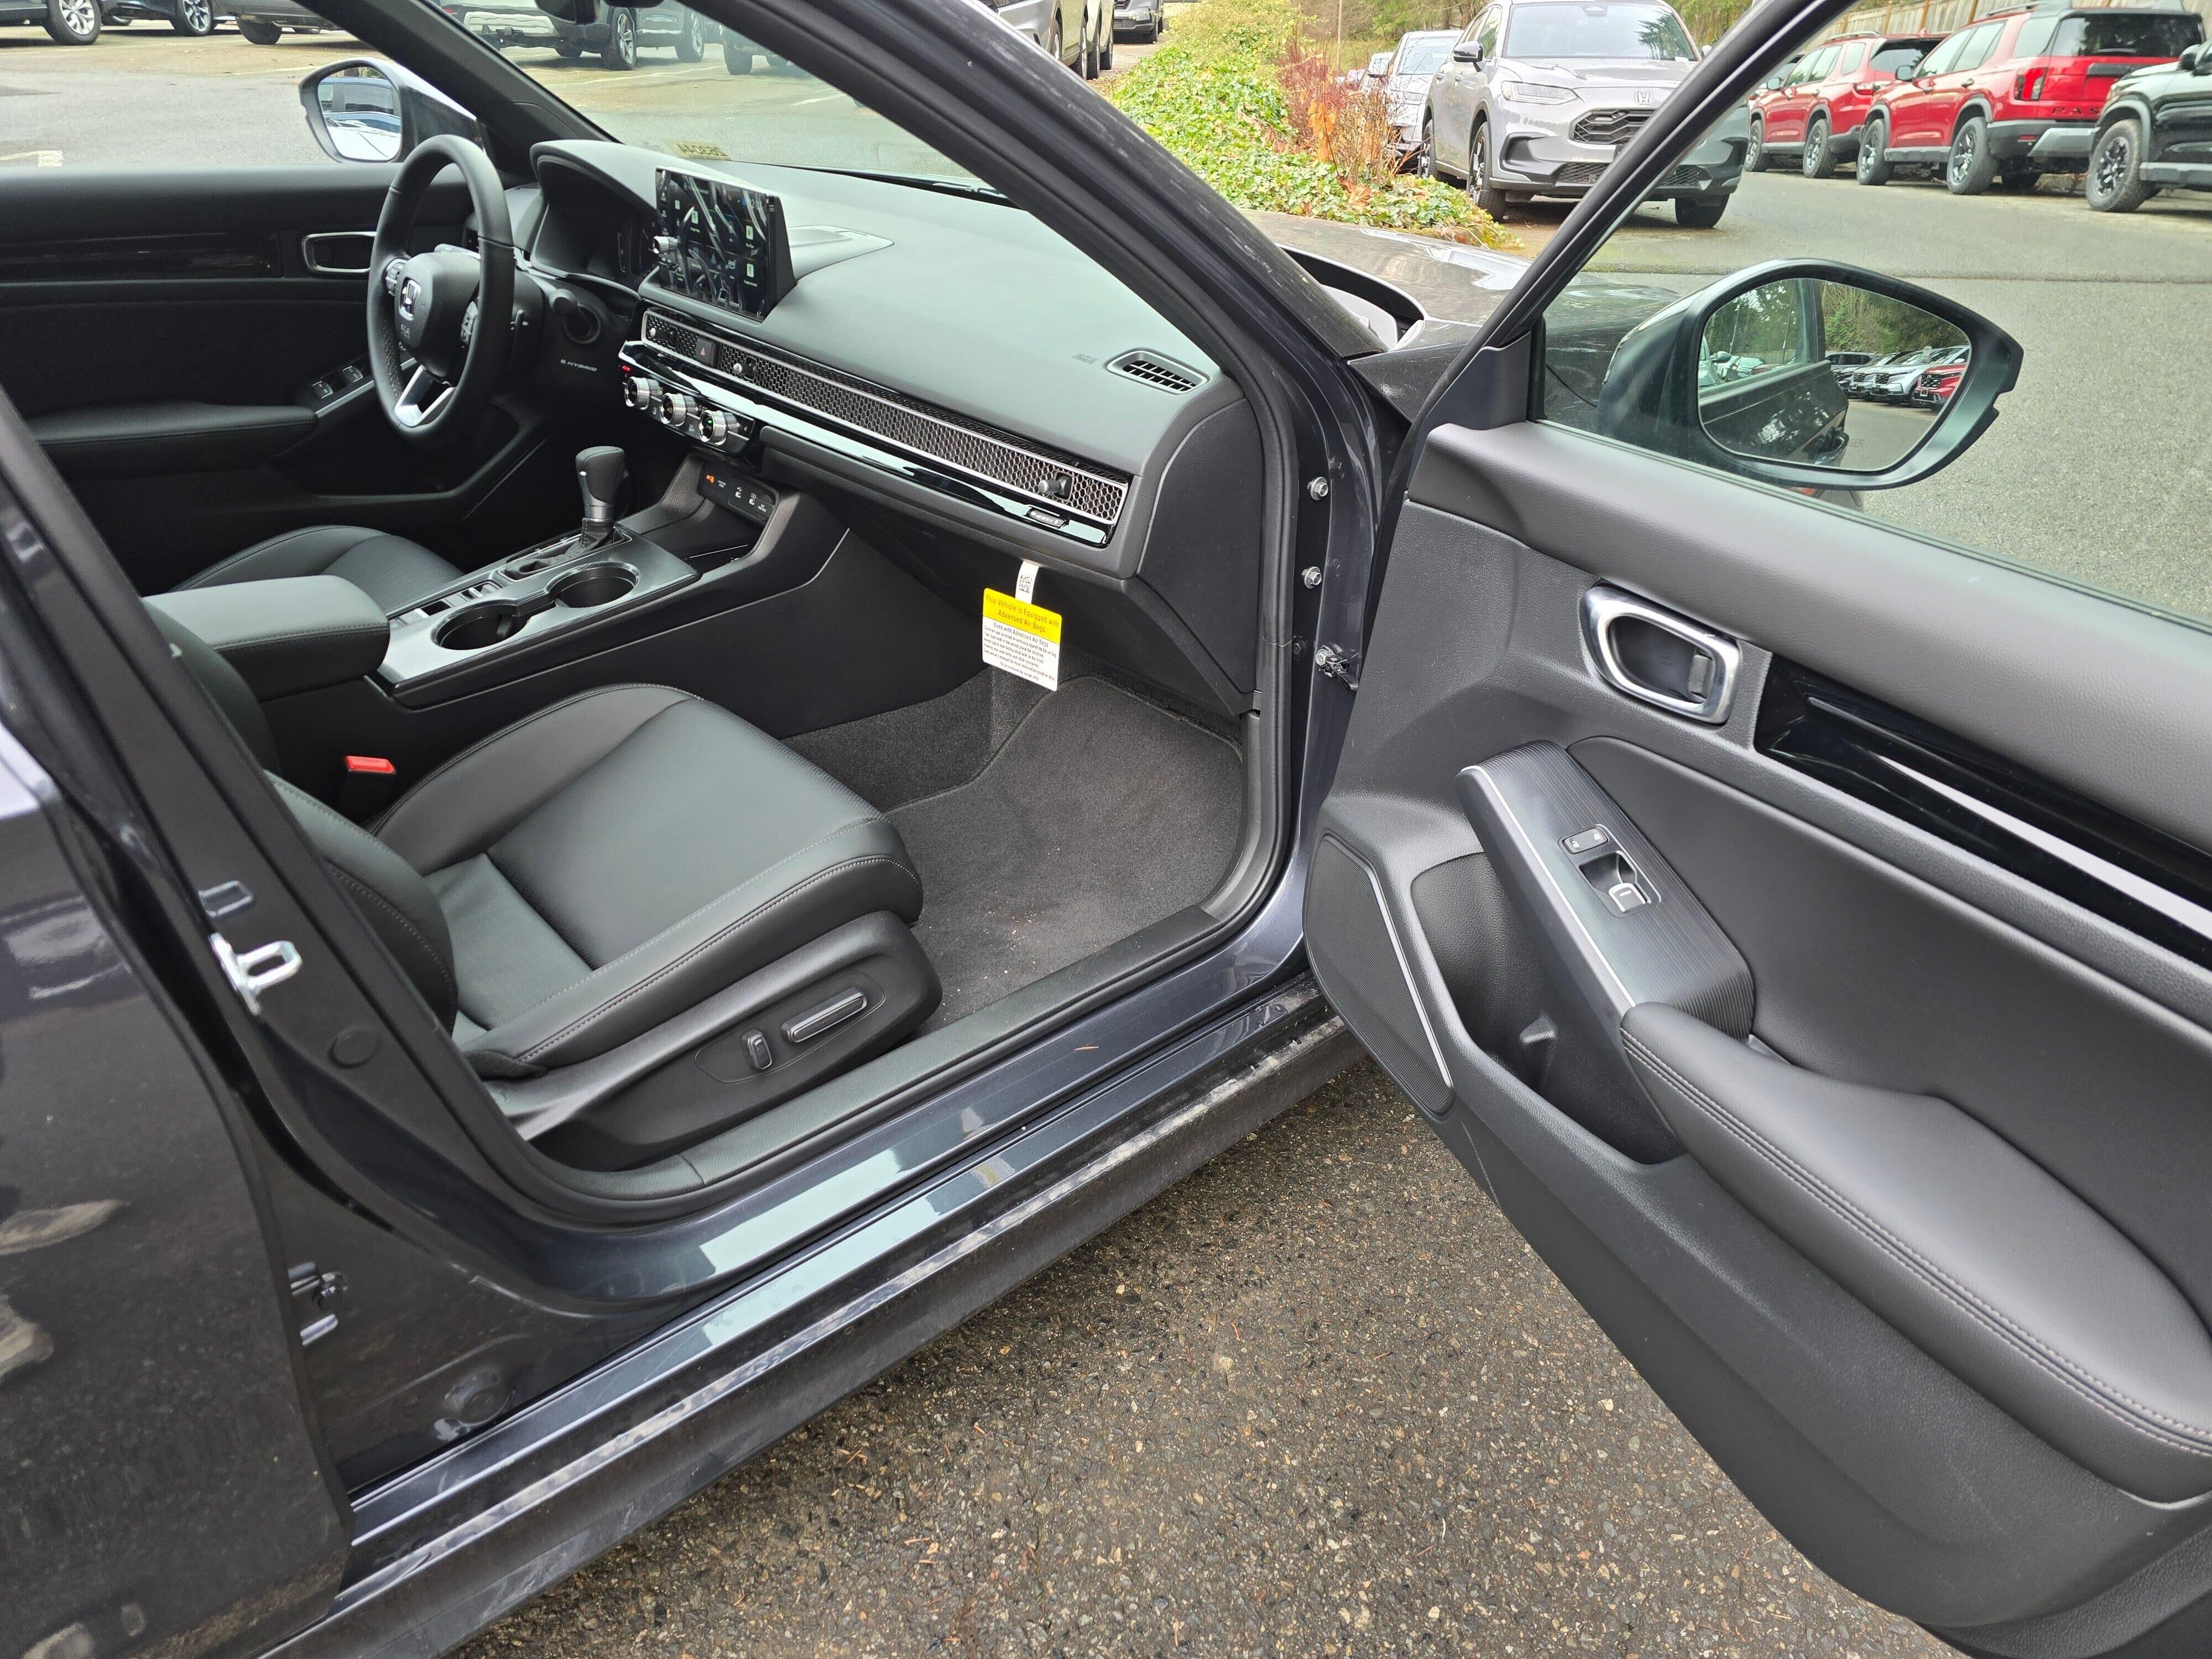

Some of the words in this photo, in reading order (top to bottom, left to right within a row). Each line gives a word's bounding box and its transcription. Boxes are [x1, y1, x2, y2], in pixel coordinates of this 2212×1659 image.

[998, 598, 1016, 612] Vehicle
[1024, 608, 1047, 623] Equipped
[1048, 619, 1059, 628] with
[998, 609, 1022, 624] Advanced
[1032, 622, 1045, 633] Bags
[993, 622, 1003, 630] Even
[1013, 629, 1031, 641] Advanced
